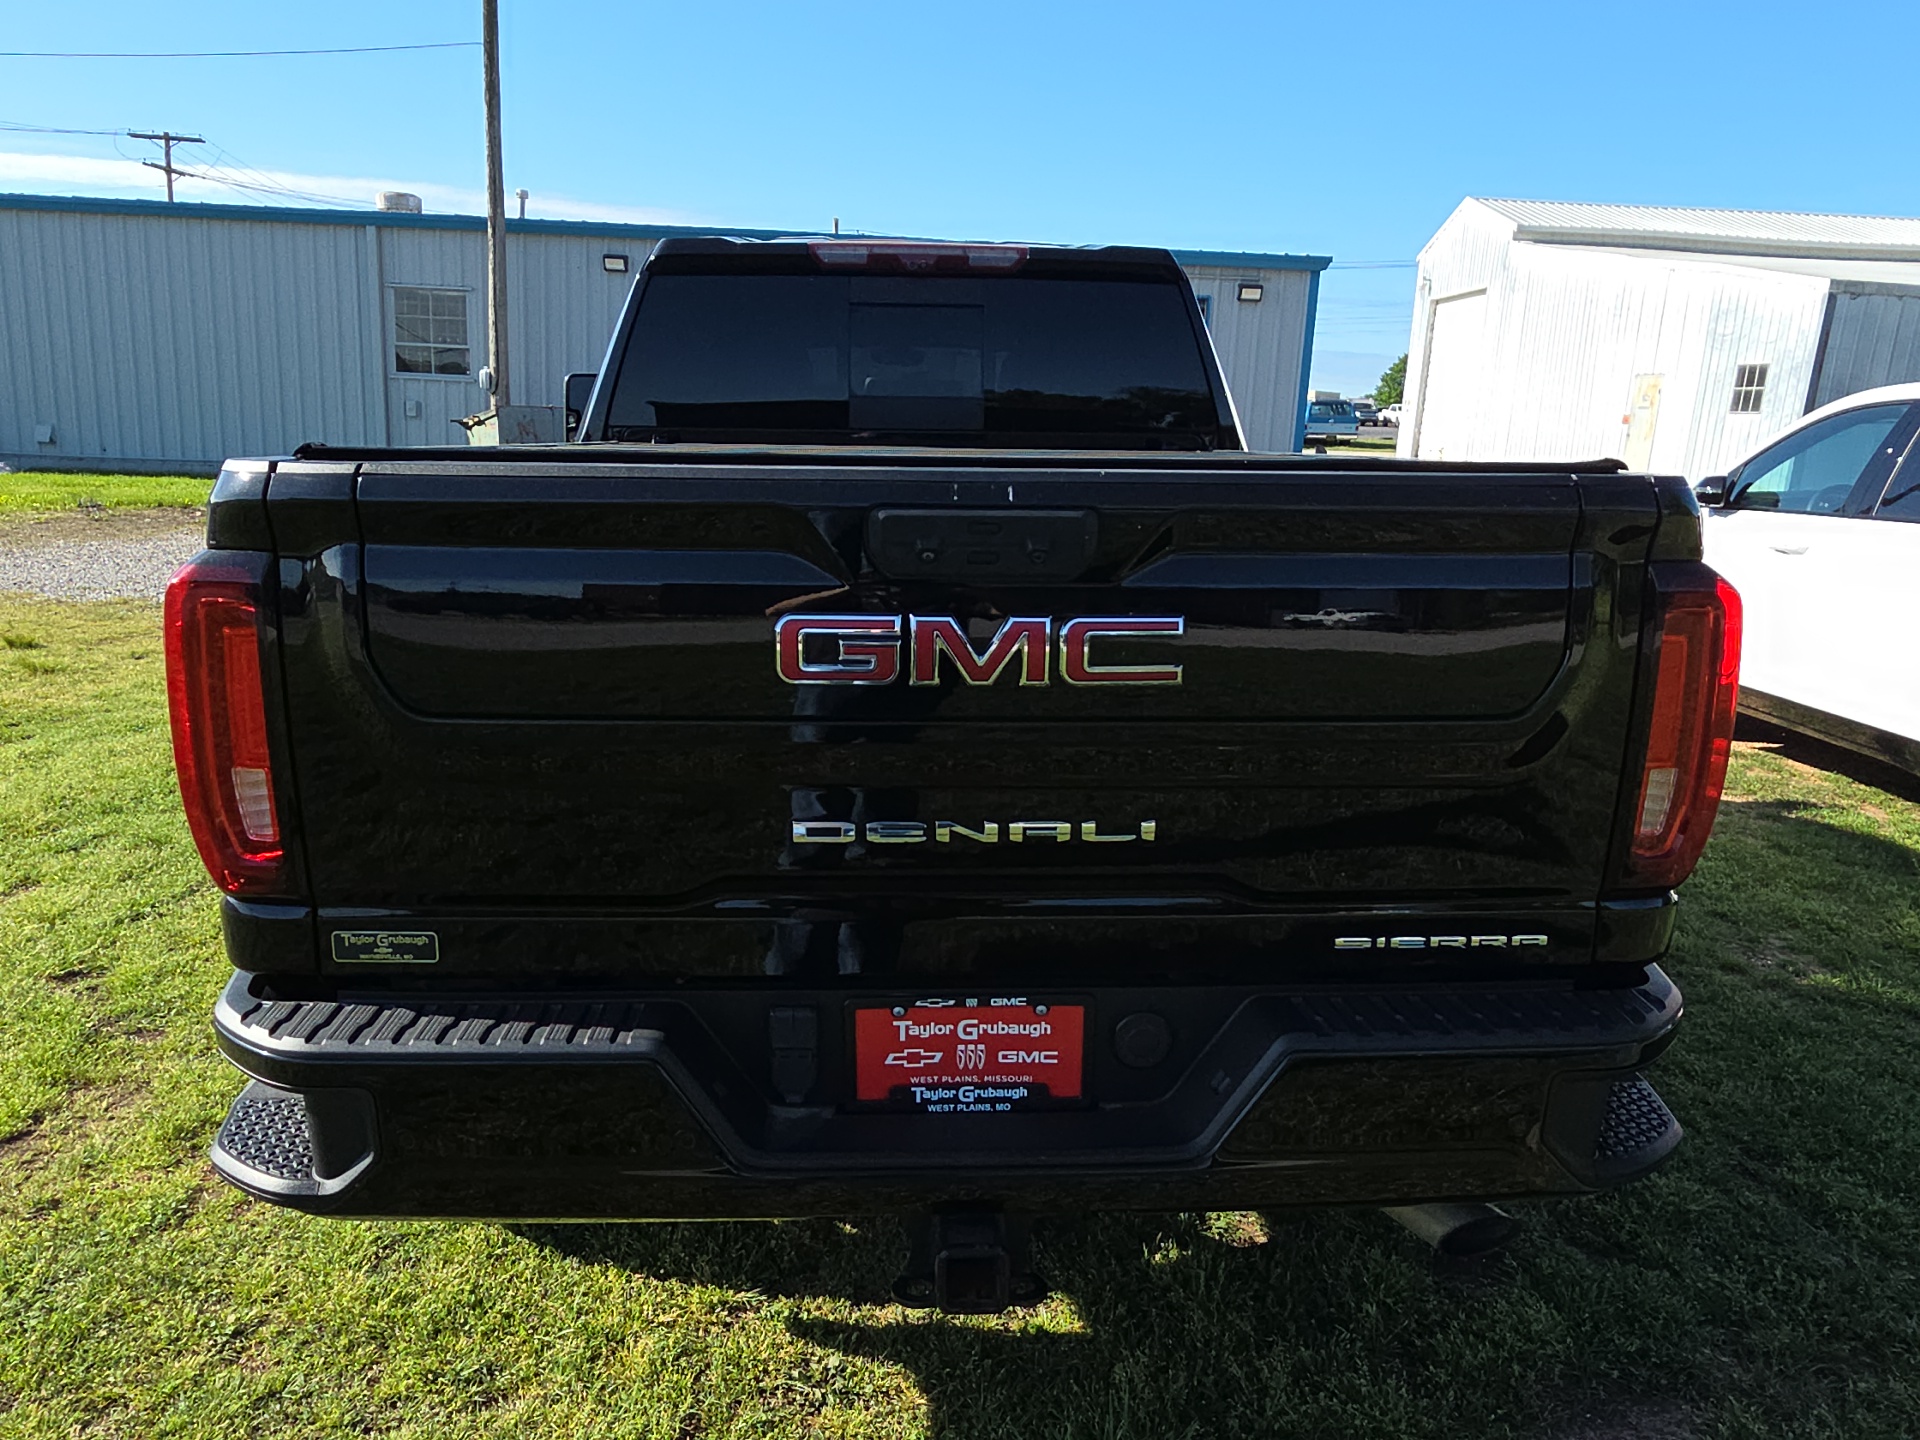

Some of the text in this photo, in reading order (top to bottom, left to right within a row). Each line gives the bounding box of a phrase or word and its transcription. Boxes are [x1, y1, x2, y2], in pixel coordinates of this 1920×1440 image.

[773, 611, 1187, 688] GMC
[791, 819, 1157, 844] DENALI
[340, 933, 429, 946] Taylor Grubaugh
[1334, 934, 1549, 949] SIERRA
[990, 997, 1027, 1007] GMC
[893, 1019, 1051, 1041] Taylor Grubaugh
[998, 1051, 1058, 1063] GMC
[909, 1075, 939, 1084] WEST
[984, 1074, 1033, 1083] MISSOURI
[911, 1085, 1028, 1103] Taylor Grubaugh
[927, 1103, 1011, 1113] WEST PLAINS, MO
